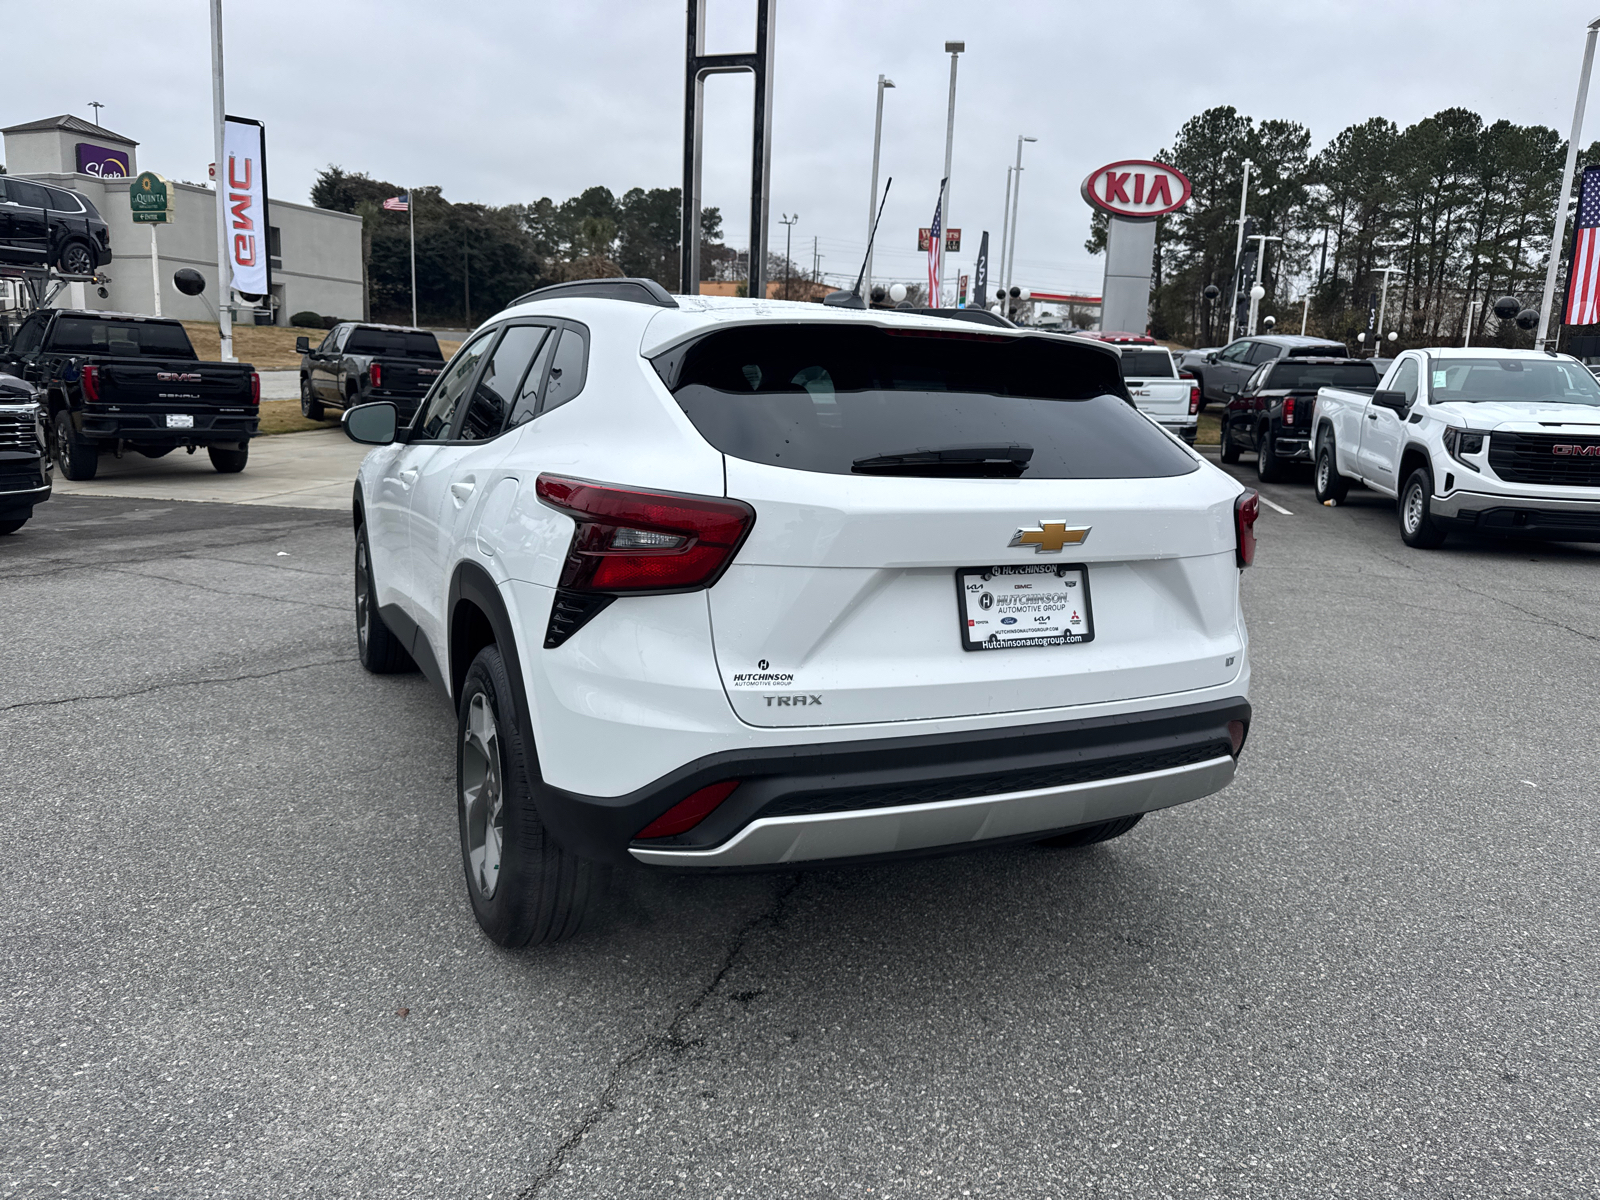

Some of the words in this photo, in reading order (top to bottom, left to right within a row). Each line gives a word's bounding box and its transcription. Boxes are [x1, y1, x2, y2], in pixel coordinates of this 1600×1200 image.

[1106, 172, 1173, 206] KIA
[137, 193, 165, 204] QUINTA
[157, 372, 202, 382] GMC
[996, 592, 1068, 607] HUTCHINSON
[998, 605, 1042, 614] AUTOMOTIVE
[1042, 604, 1066, 612] GROUP
[982, 636, 1082, 649] Hutchinsonautogroup.com
[763, 695, 822, 706] TRAX
